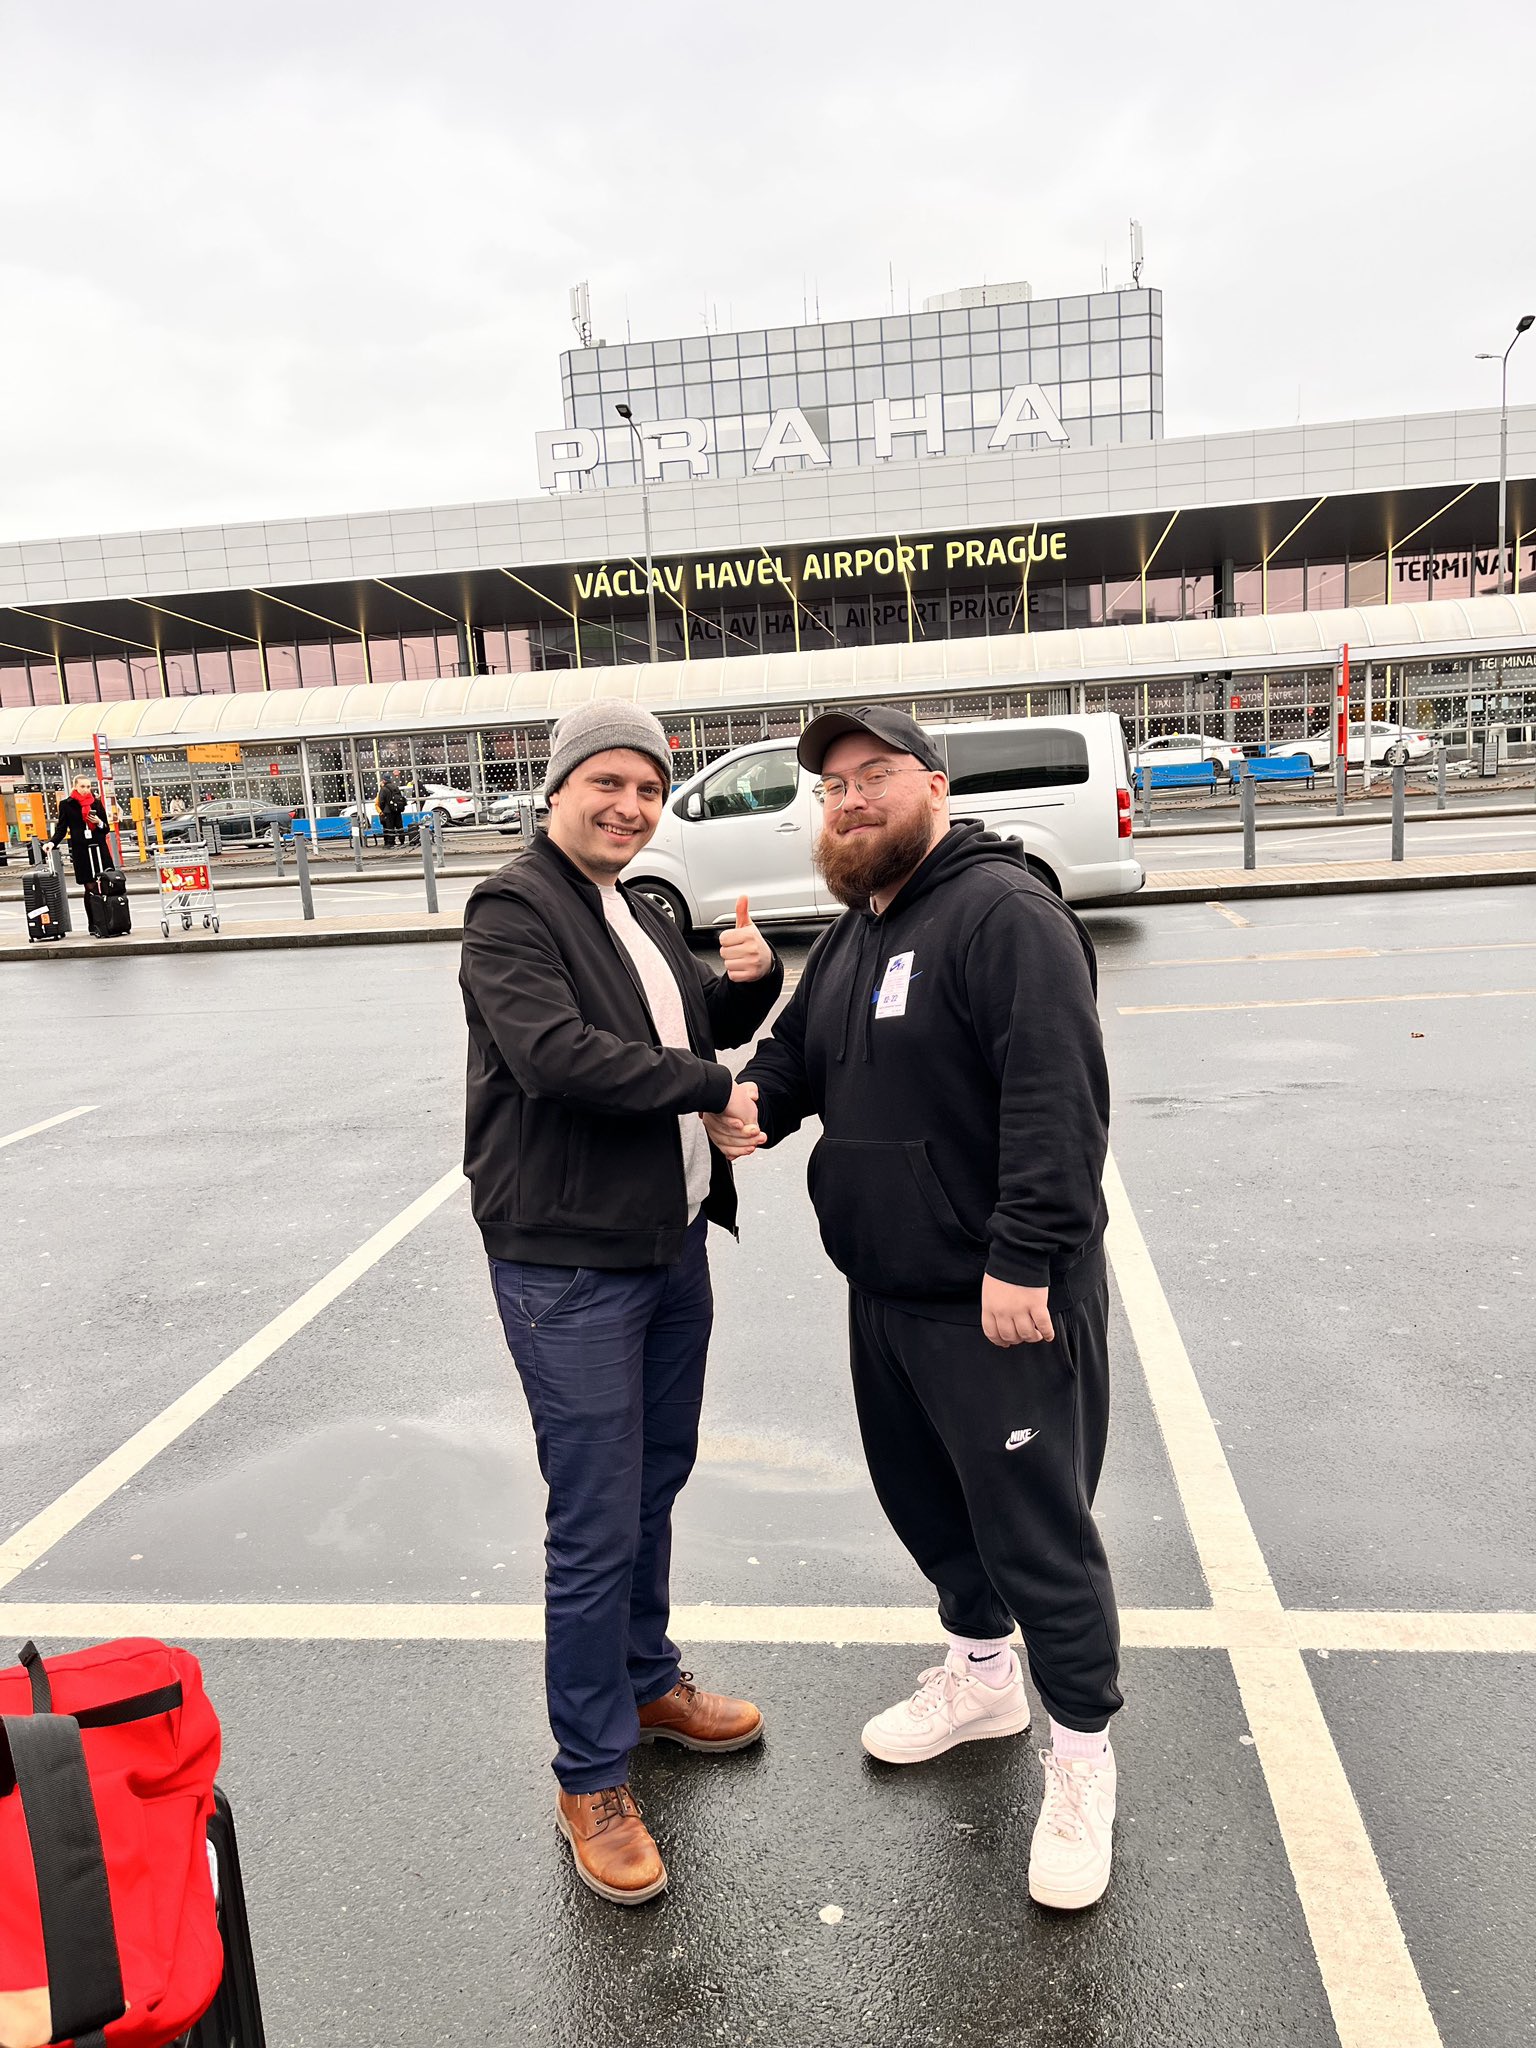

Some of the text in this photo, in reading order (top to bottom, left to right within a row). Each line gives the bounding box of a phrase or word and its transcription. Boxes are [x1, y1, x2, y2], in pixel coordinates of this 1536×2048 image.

[535, 383, 1070, 489] PRAHA
[573, 532, 1068, 599] VÁCLAV HAVEL AIRPORT PRAGUE
[845, 601, 940, 628] AIRPORT
[949, 594, 1039, 620] PRAGUE
[1010, 1428, 1033, 1443] NIKE
